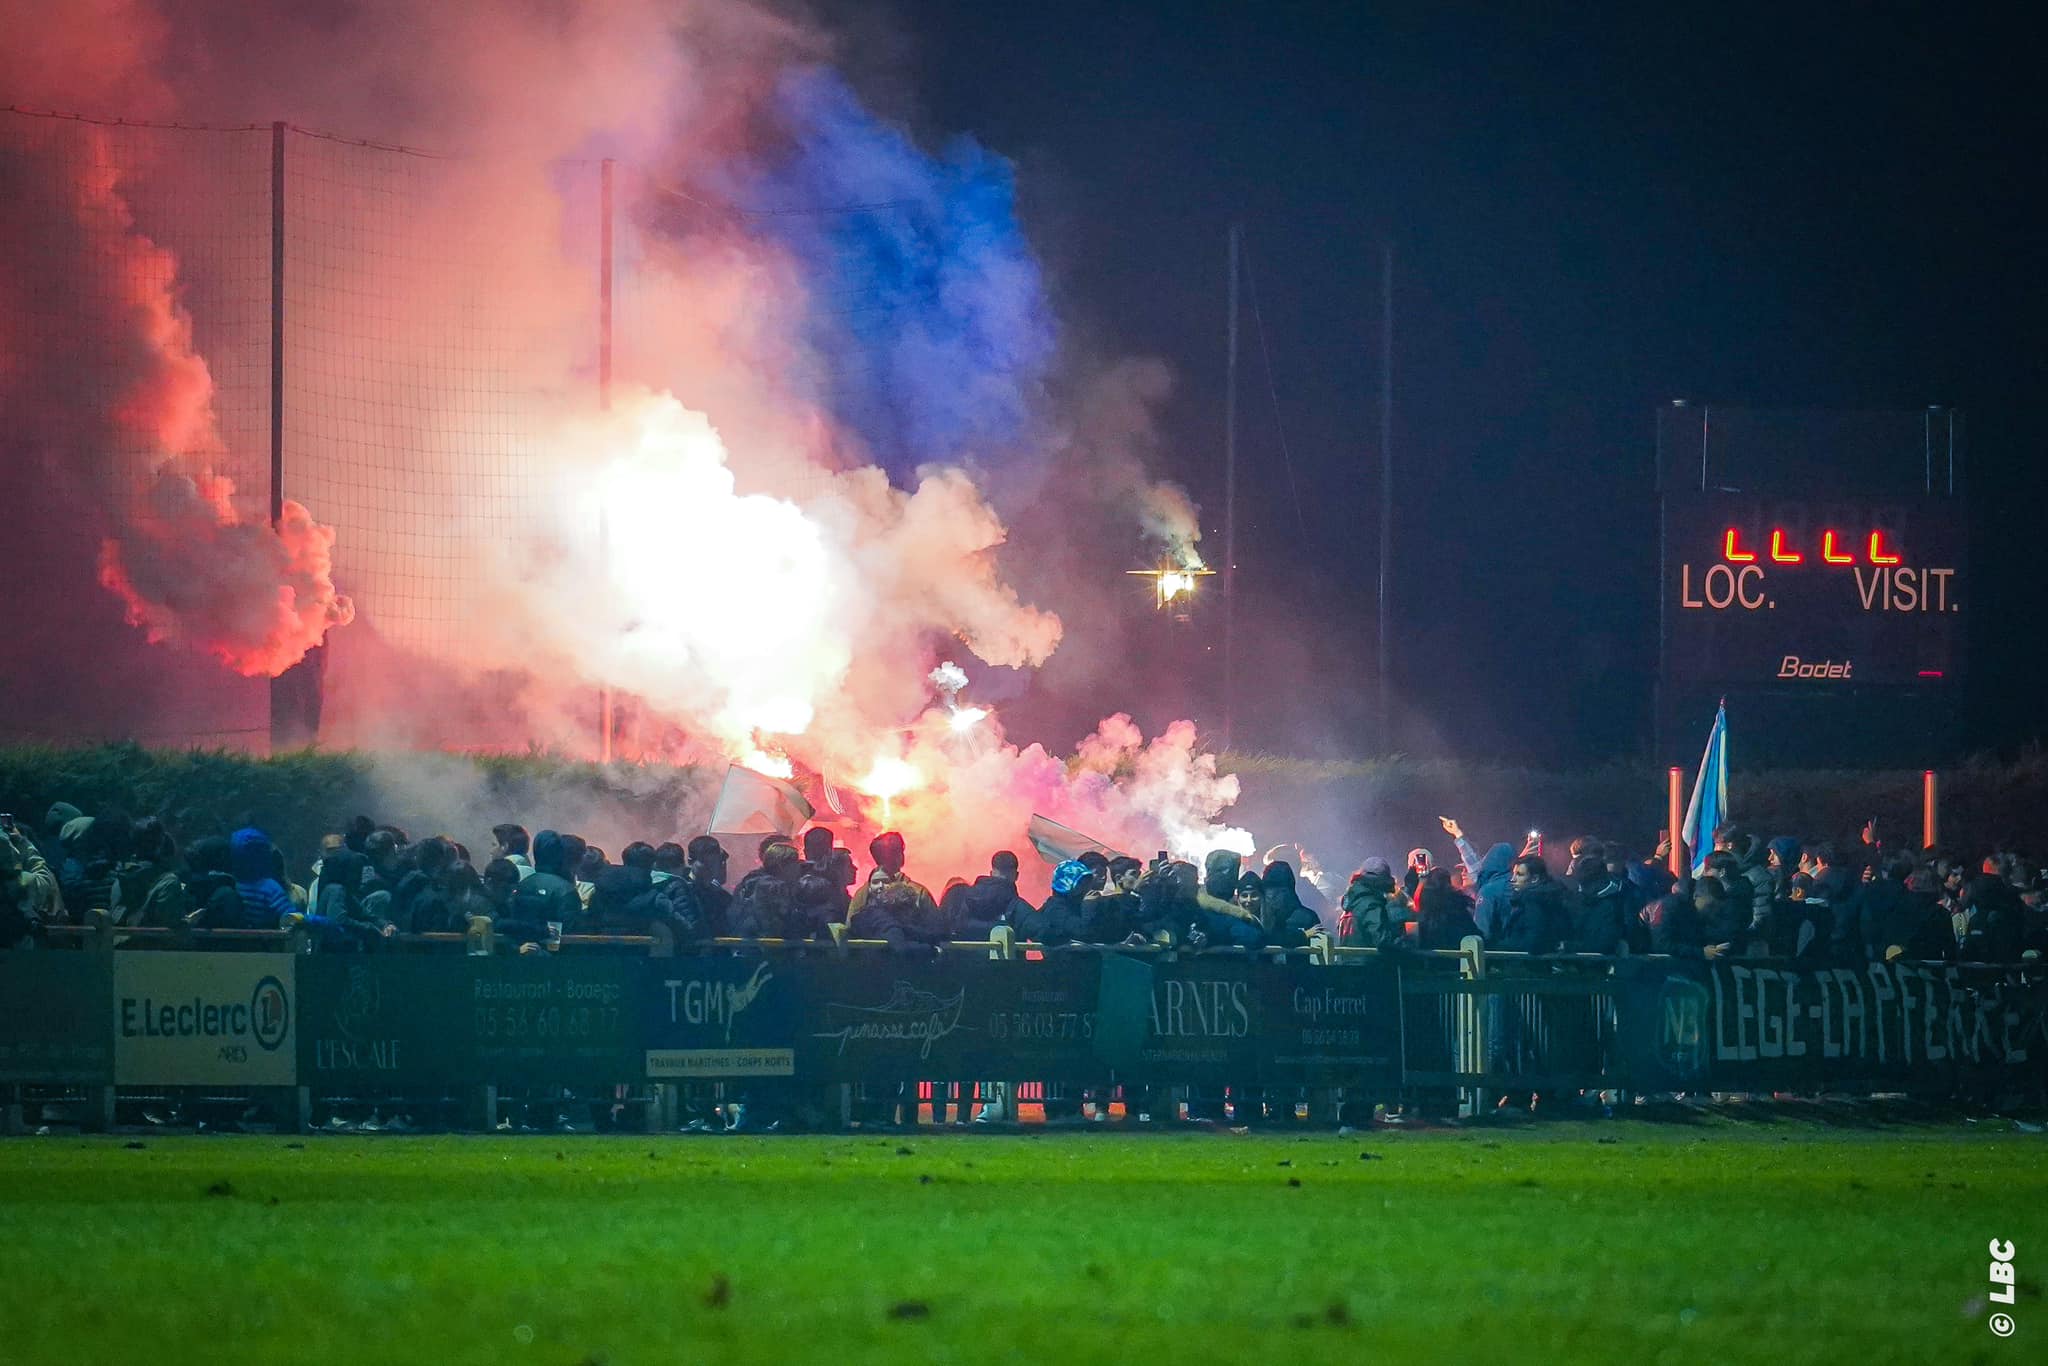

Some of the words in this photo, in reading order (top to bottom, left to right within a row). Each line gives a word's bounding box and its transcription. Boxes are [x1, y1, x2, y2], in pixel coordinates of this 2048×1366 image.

[1681, 563, 1776, 610] LOC.
[1853, 566, 1959, 612] VISIT.
[1776, 655, 1852, 679] Bodet
[663, 979, 725, 1025] TGM
[1293, 985, 1321, 1022] Cap
[1325, 986, 1368, 1015] Ferret
